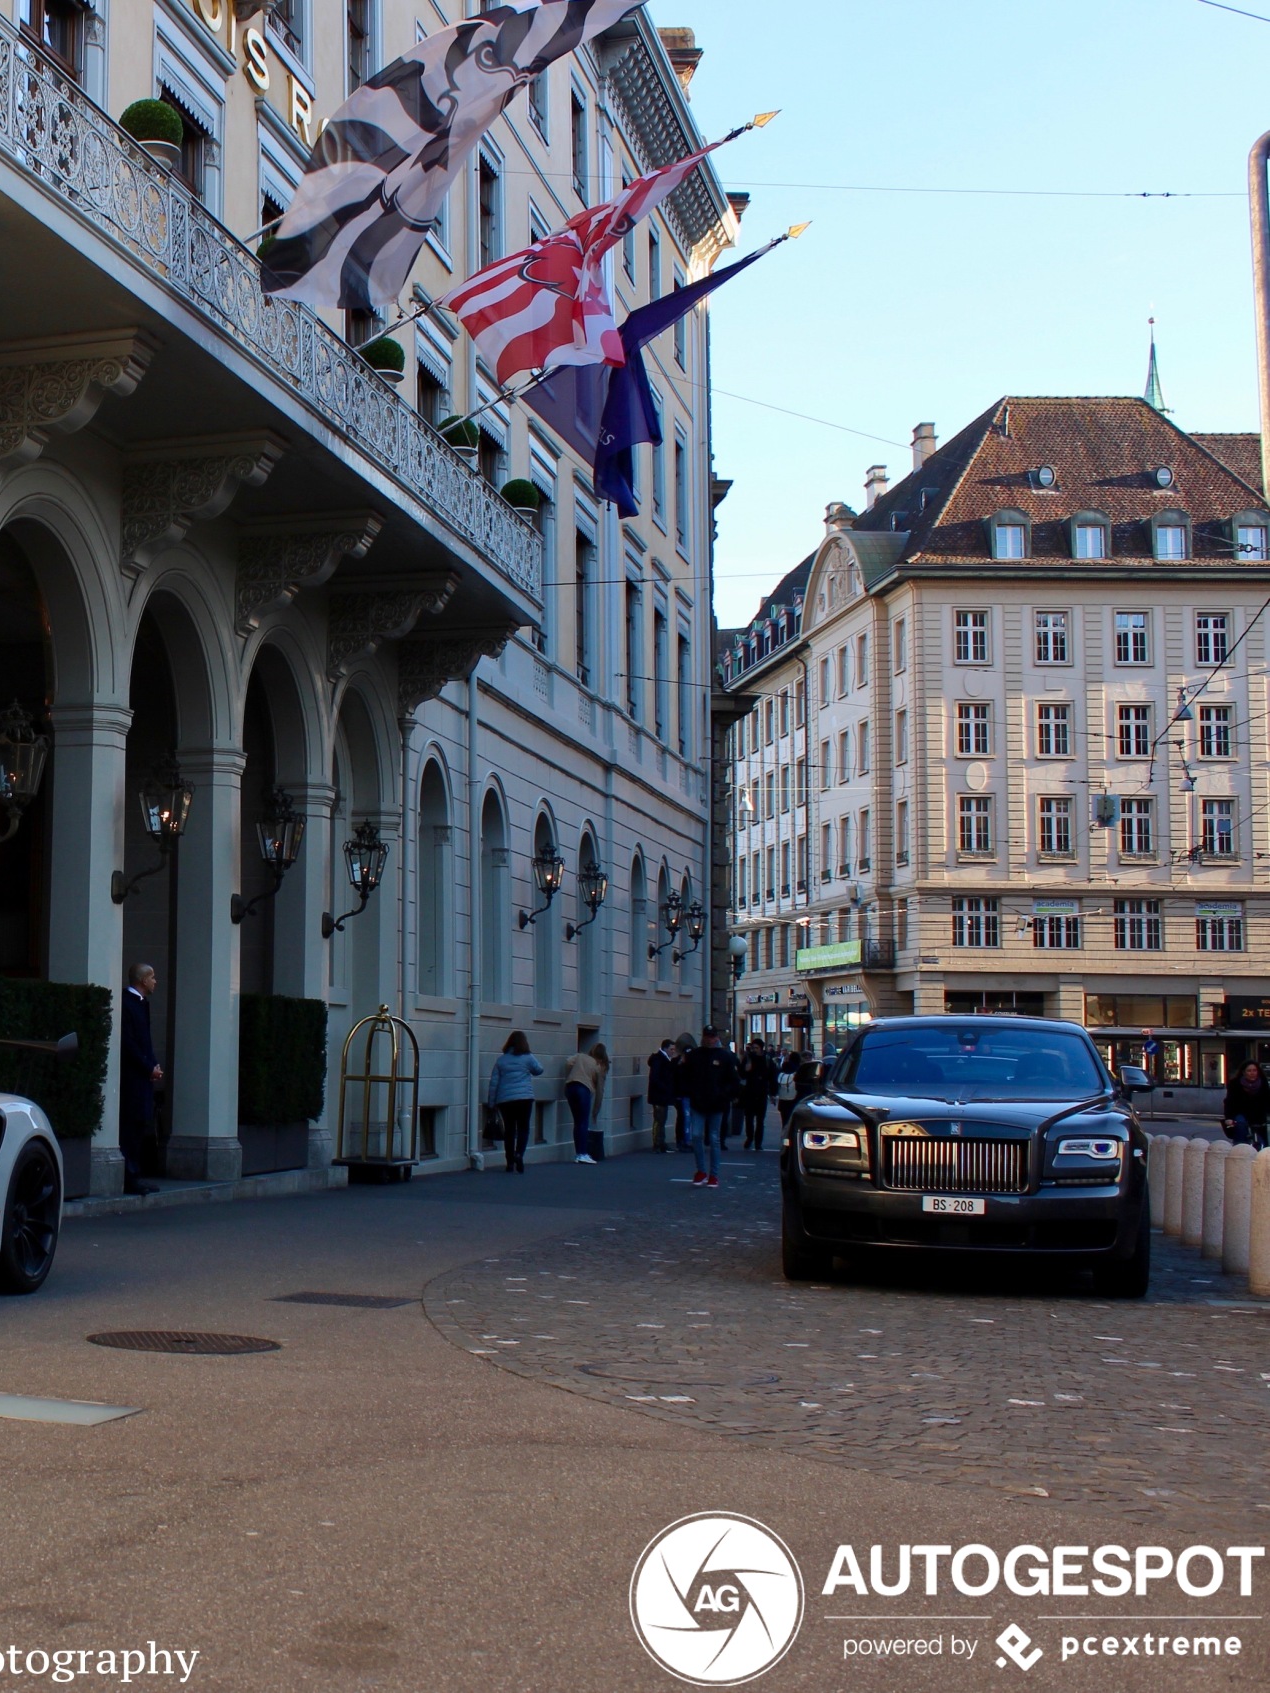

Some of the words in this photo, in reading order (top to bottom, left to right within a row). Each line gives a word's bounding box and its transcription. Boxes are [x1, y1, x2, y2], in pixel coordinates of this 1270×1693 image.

[1036, 899, 1074, 907] academia
[1198, 901, 1237, 909] academia
[1241, 1008, 1254, 1017] 2x
